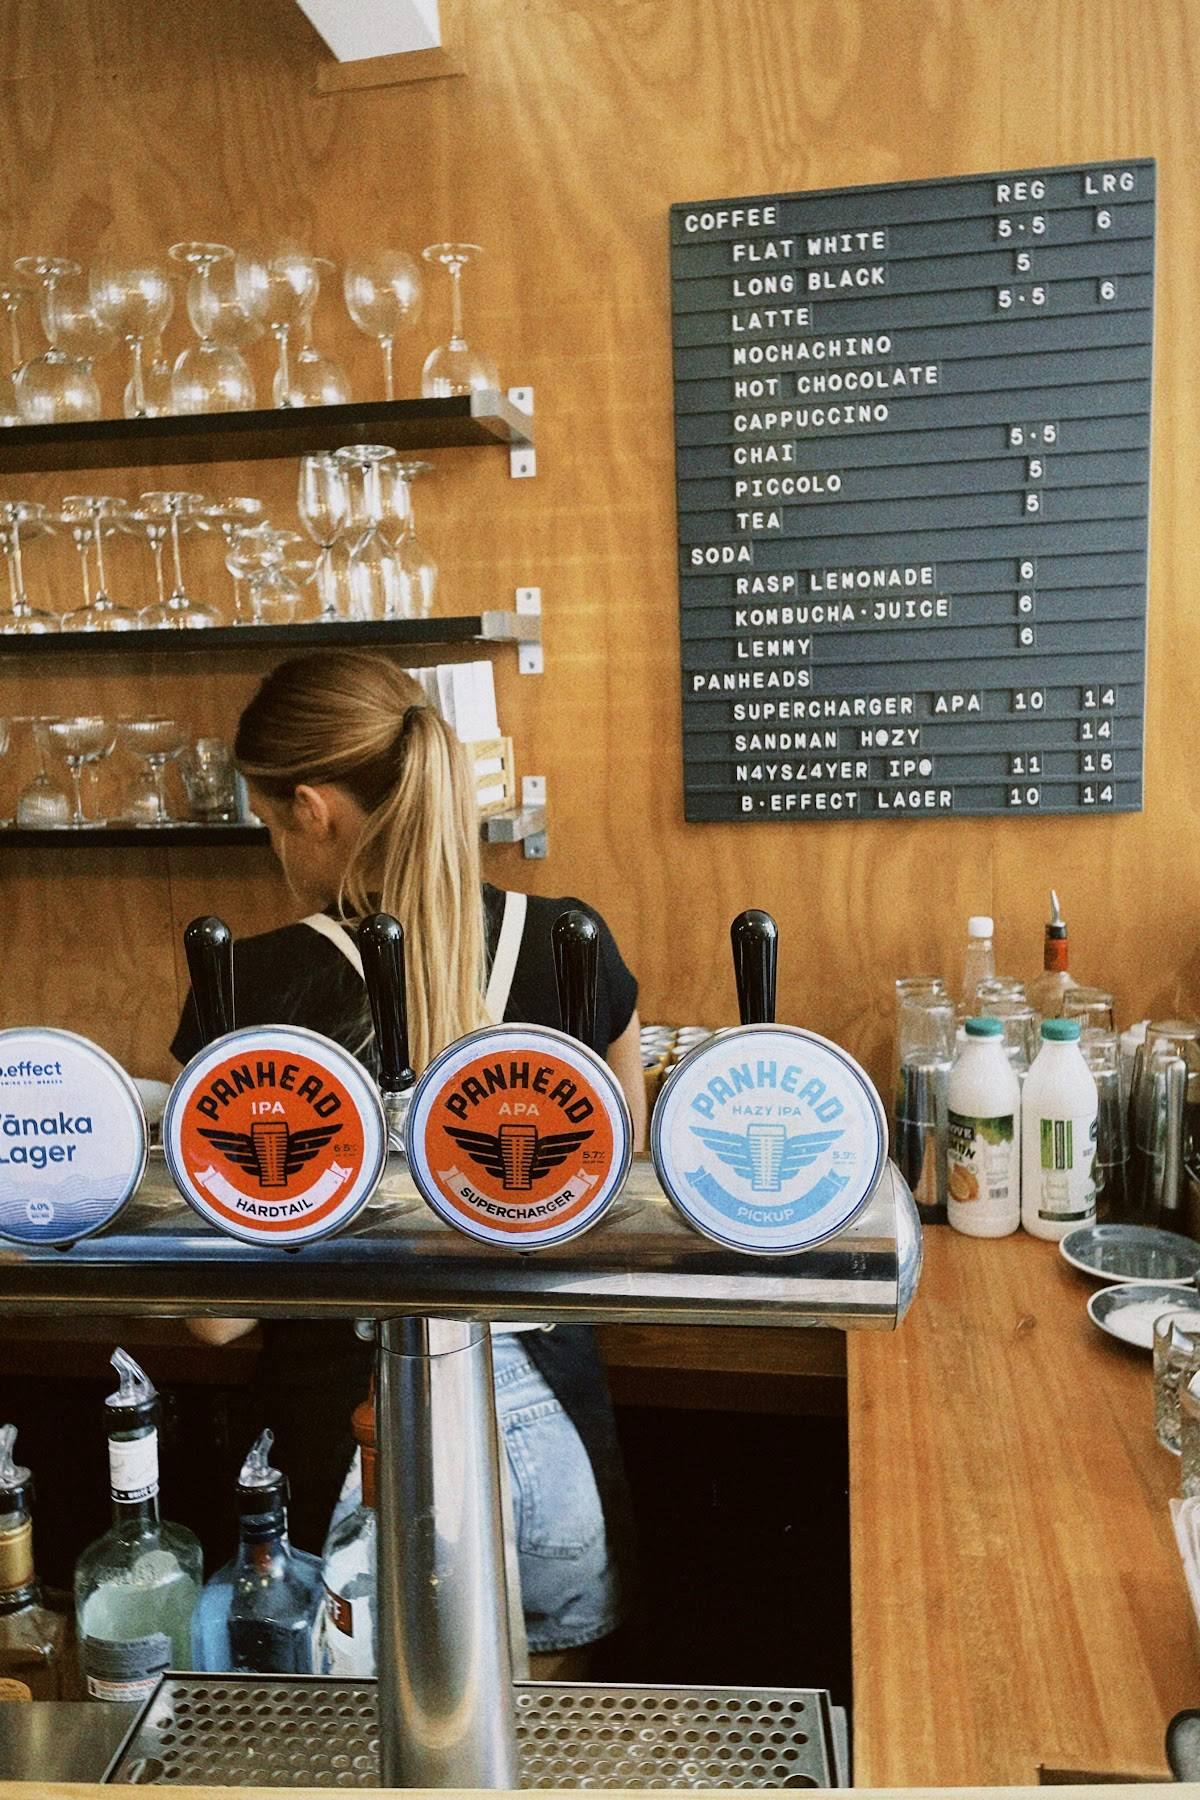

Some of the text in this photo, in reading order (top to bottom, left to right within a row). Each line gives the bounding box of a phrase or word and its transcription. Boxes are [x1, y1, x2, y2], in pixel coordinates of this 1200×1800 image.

[685, 172, 1134, 233] COFFEE REG LRG
[733, 239, 794, 262] FLAT
[807, 231, 885, 256] WHITE
[1097, 210, 1112, 229] 6
[733, 253, 1031, 297] LONG BLACK 5
[732, 307, 809, 332] LATTE
[1100, 281, 1116, 300] 6
[733, 335, 892, 365] MOCHACHINO
[735, 365, 938, 398] HOT CHOCOLATE
[734, 404, 889, 432] CAPPUCCINO
[734, 443, 793, 465] CHAI
[735, 459, 1043, 498] PICCOLO 5
[736, 494, 1040, 530] TEA 5
[691, 545, 751, 566] SODA
[736, 561, 1034, 595] RASP LEMONADE 6
[1019, 594, 1032, 613] 6
[737, 627, 1034, 658] LEMMY 6
[693, 670, 810, 691] PANHEADS
[733, 689, 1115, 721] SUPERCHARGER APA 10 14
[735, 731, 837, 752] SANDMAN
[1082, 721, 1111, 740] 14
[1013, 756, 1041, 774] 11
[1083, 753, 1113, 772] 15
[878, 790, 952, 809] LAGER
[1010, 787, 1039, 805] 10
[1083, 785, 1113, 803] 14
[0, 1061, 62, 1077] .effect
[196, 1061, 342, 1121] PANHEAD
[444, 1061, 594, 1124] PANHEAD
[690, 1060, 845, 1124] PANHEAD
[251, 1101, 286, 1116] IPA
[498, 1102, 541, 1117] APA
[732, 1105, 802, 1116] HAZY IPA
[0, 1111, 93, 1137] ānaka
[236, 1198, 314, 1218] HARDTAIL
[460, 1186, 576, 1219] SUPERCHARGER
[736, 1207, 795, 1223] PICKUP
